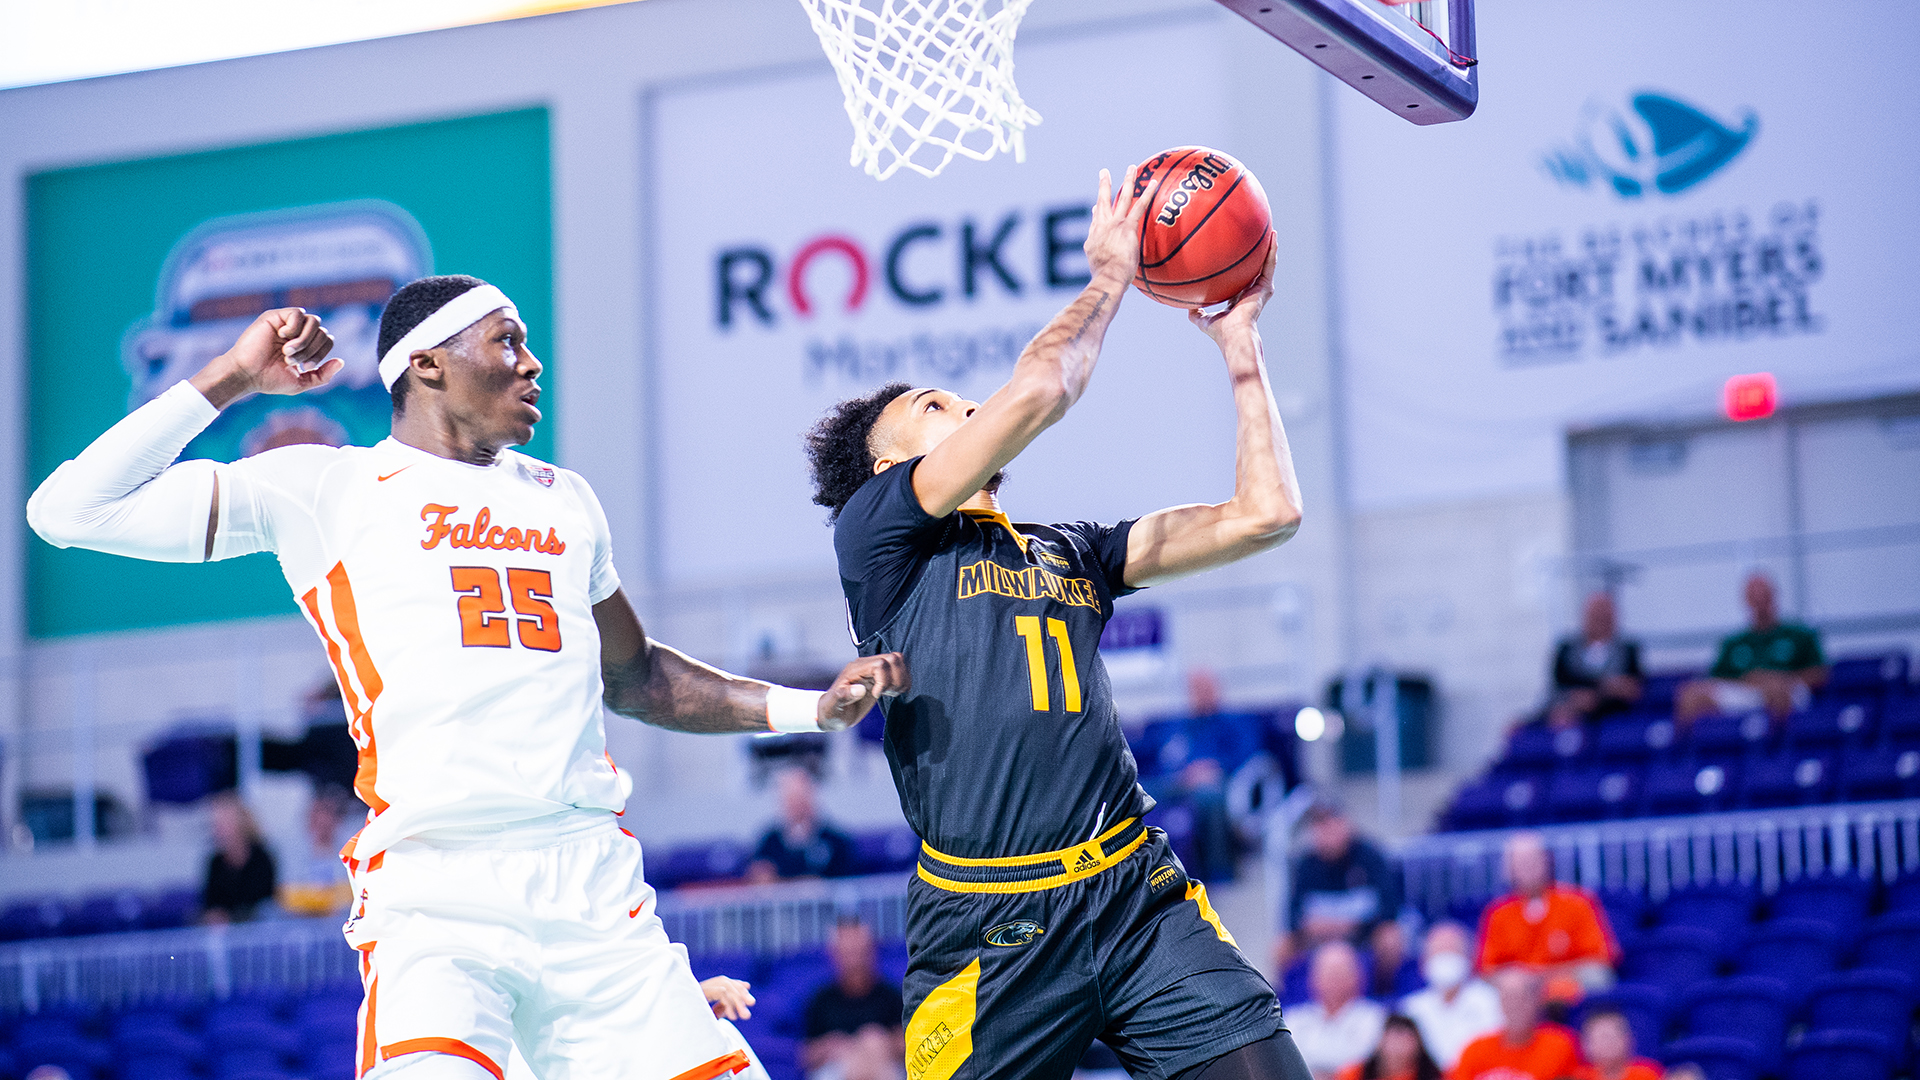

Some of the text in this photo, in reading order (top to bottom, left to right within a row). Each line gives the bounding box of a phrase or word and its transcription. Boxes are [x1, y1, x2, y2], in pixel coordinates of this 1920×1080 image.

[1155, 153, 1233, 227] Wilson
[1495, 239, 1823, 309] FORT MYERS
[1602, 294, 1824, 353] SANIBEL
[421, 503, 566, 555] Falcons
[449, 566, 562, 652] 25
[1013, 615, 1081, 713] 11
[1073, 860, 1101, 873] adidas
[1150, 867, 1176, 887] HORIZON
